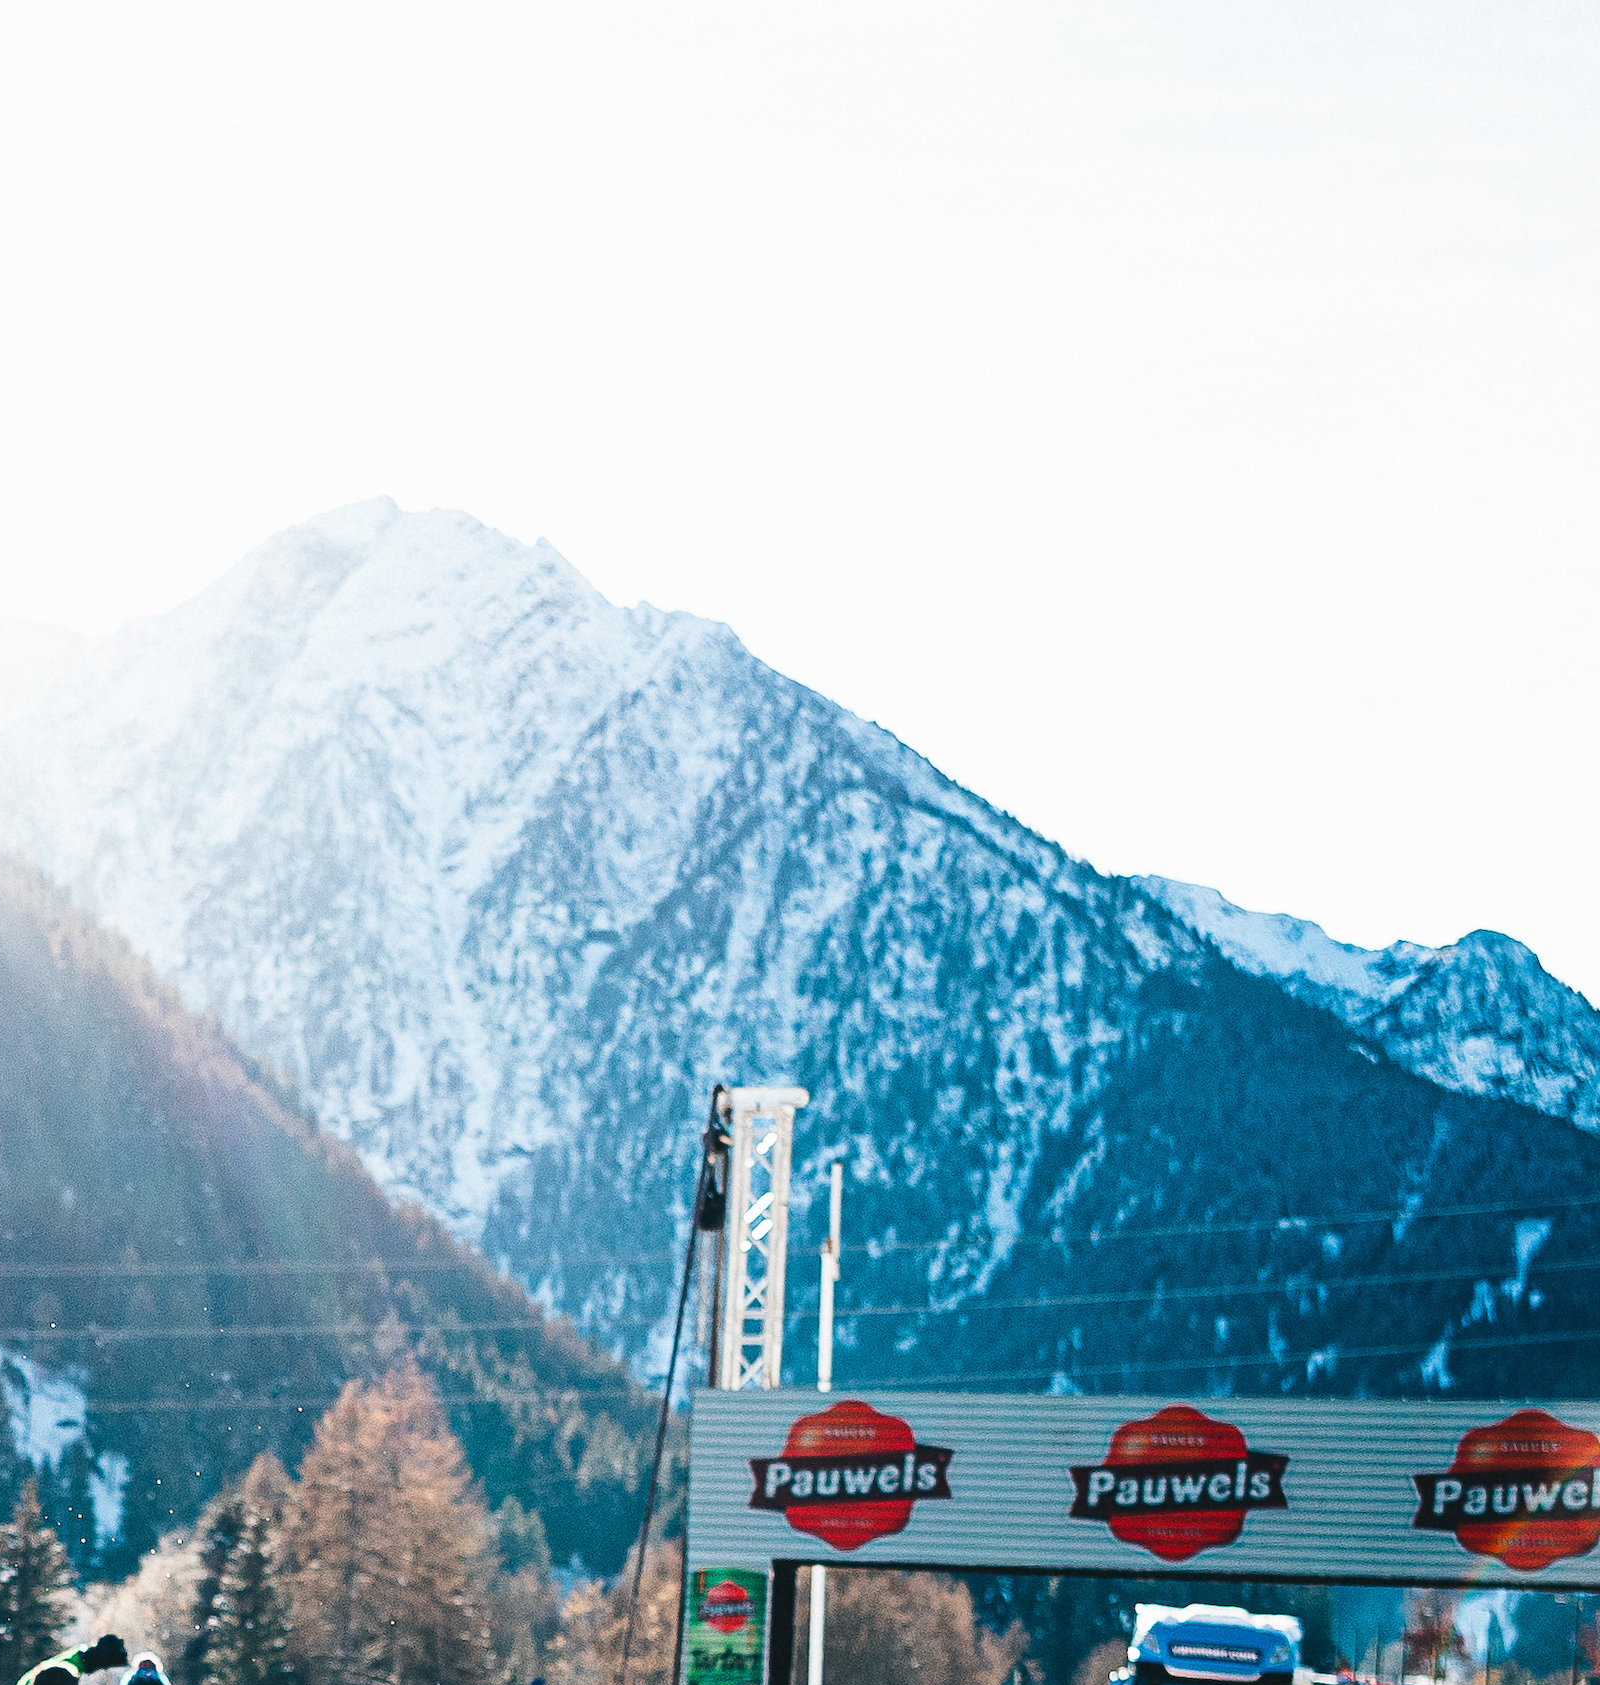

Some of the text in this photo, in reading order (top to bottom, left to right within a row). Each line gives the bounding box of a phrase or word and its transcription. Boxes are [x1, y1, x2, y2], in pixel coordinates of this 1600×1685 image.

[764, 1452, 937, 1499] Pauwels
[1086, 1460, 1271, 1508] Pauwels
[1433, 1468, 1600, 1517] Pauwel
